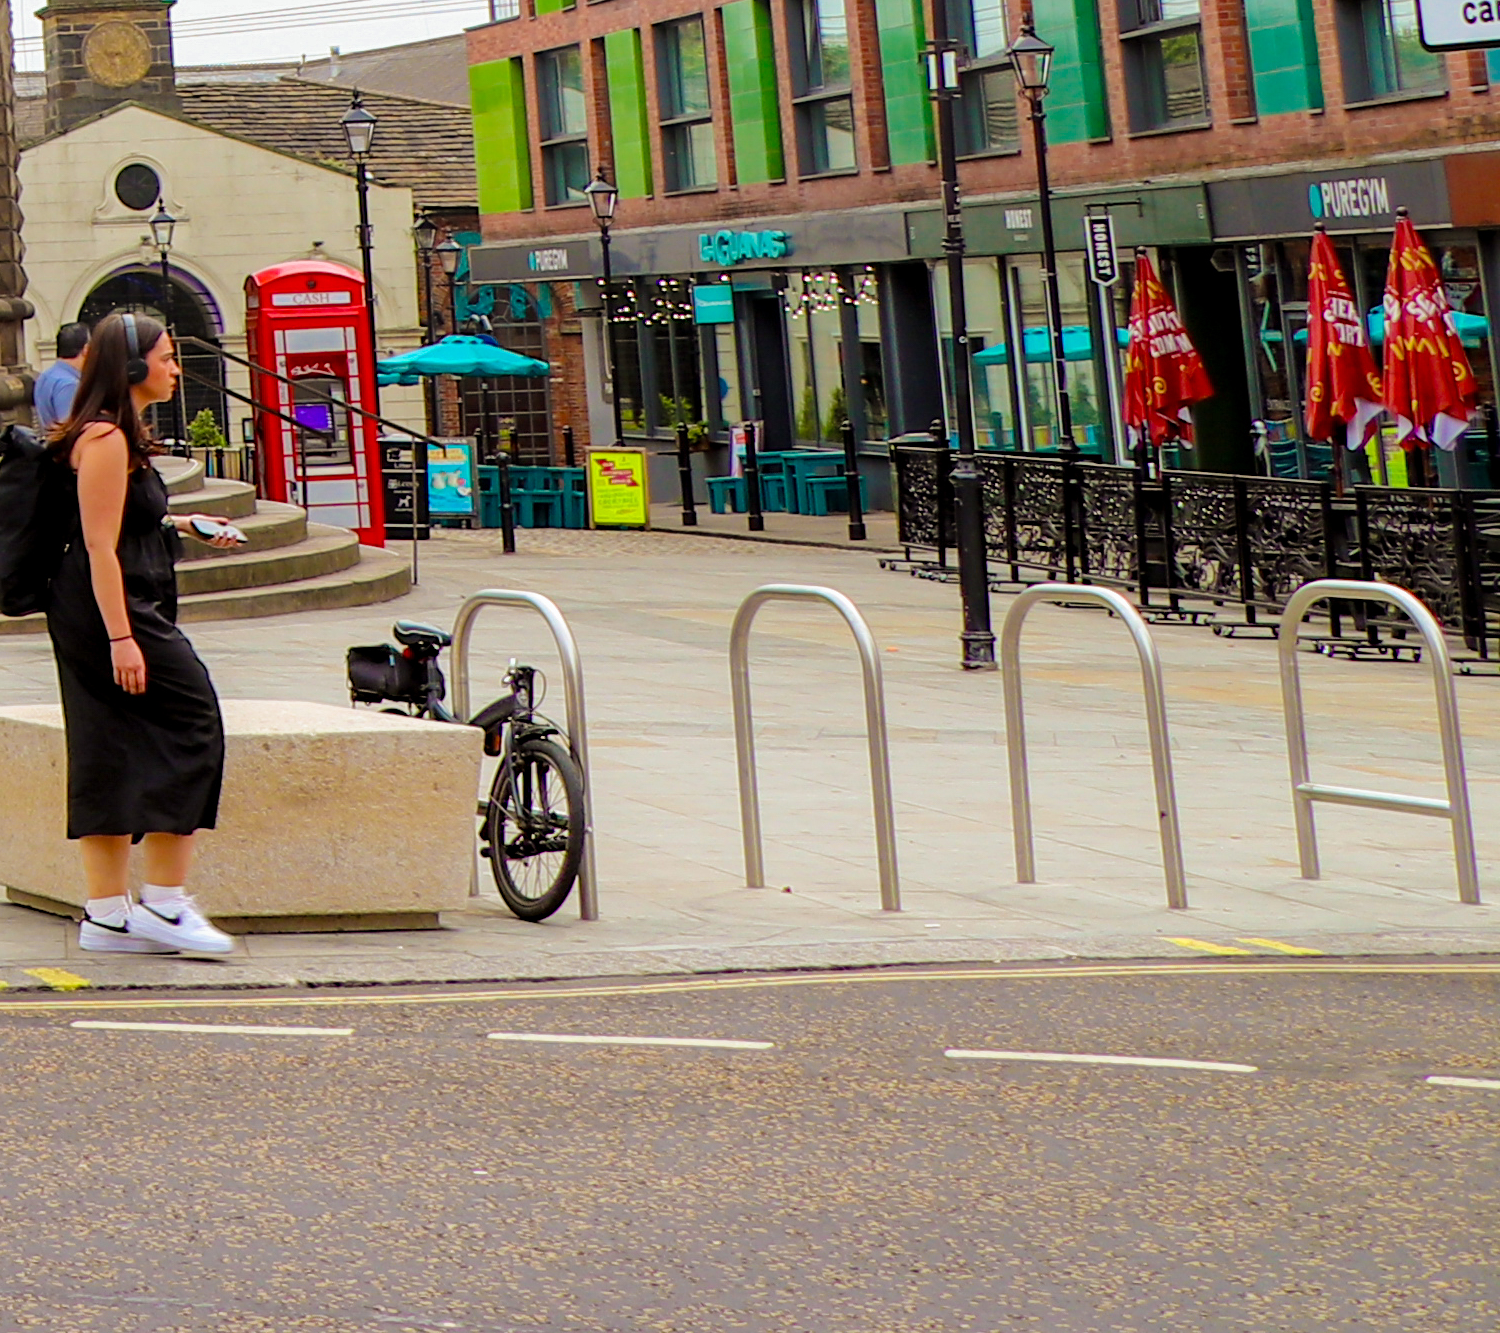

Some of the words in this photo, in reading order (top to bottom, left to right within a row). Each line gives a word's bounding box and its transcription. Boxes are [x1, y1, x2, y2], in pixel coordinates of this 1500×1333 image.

[1321, 177, 1390, 218] PUREGYM
[1005, 208, 1033, 229] HONEST
[1092, 223, 1112, 276] HONEST
[293, 293, 330, 304] CASH
